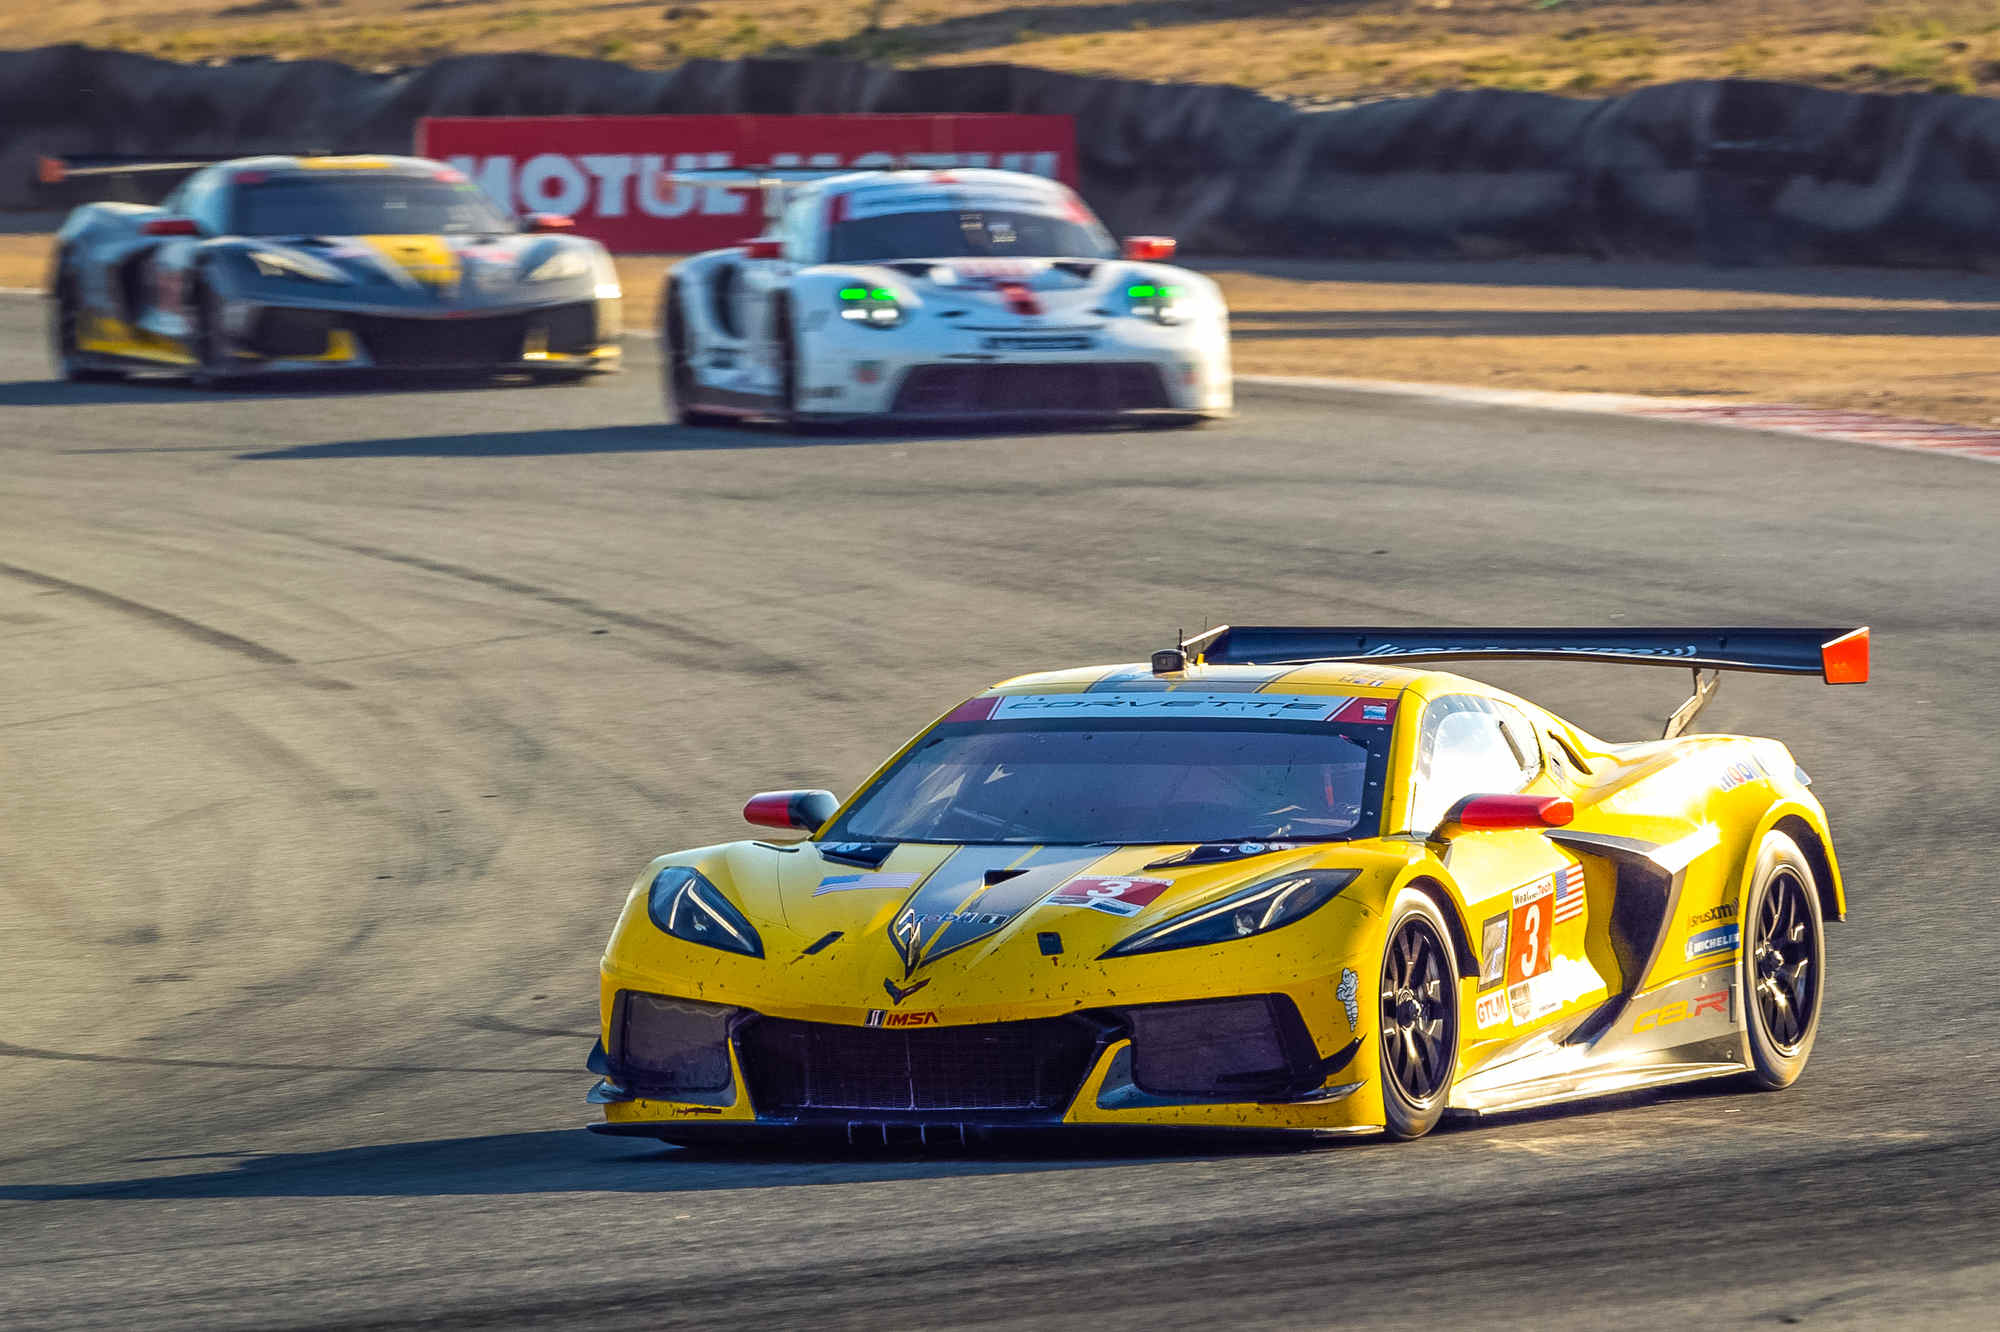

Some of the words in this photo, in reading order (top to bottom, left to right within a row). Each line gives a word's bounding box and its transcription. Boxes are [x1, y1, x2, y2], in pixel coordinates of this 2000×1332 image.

[1007, 699, 1327, 711] CORVETTE
[1086, 880, 1133, 898] 3
[1520, 904, 1540, 977] 3
[886, 1012, 938, 1026] IMSA
[1477, 993, 1506, 1024] GTLM
[1631, 989, 1729, 1035] C8.R
